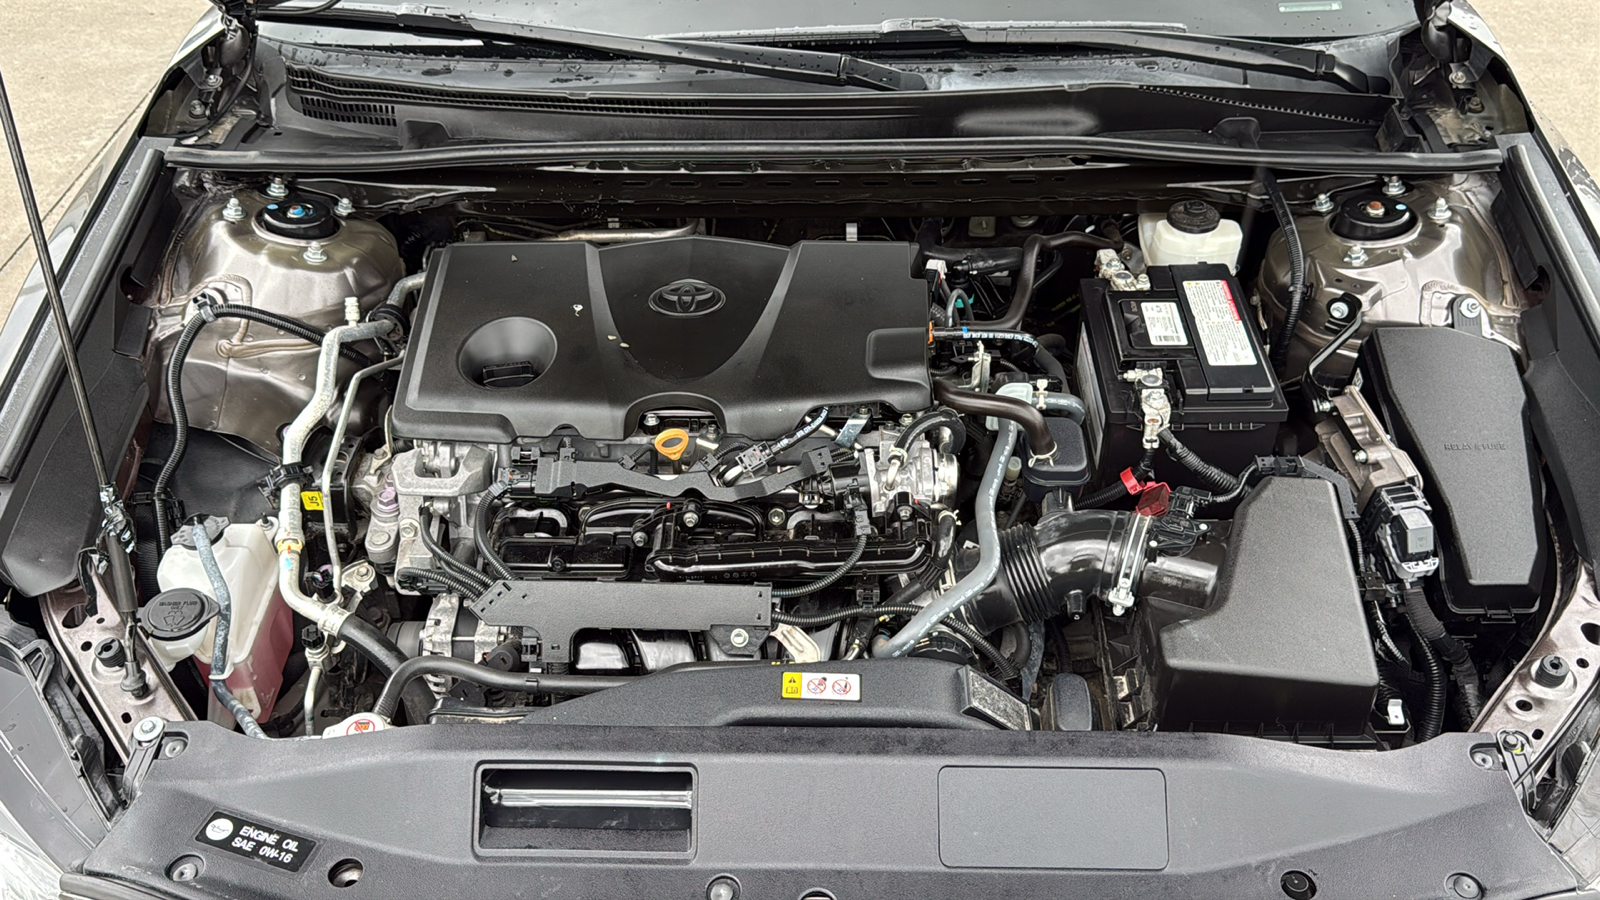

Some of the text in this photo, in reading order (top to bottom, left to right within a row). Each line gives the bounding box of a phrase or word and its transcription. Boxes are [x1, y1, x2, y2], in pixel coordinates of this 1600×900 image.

[308, 496, 319, 506] J5
[231, 837, 293, 863] SAE 0W-16
[239, 826, 299, 852] ENGINE OIL
